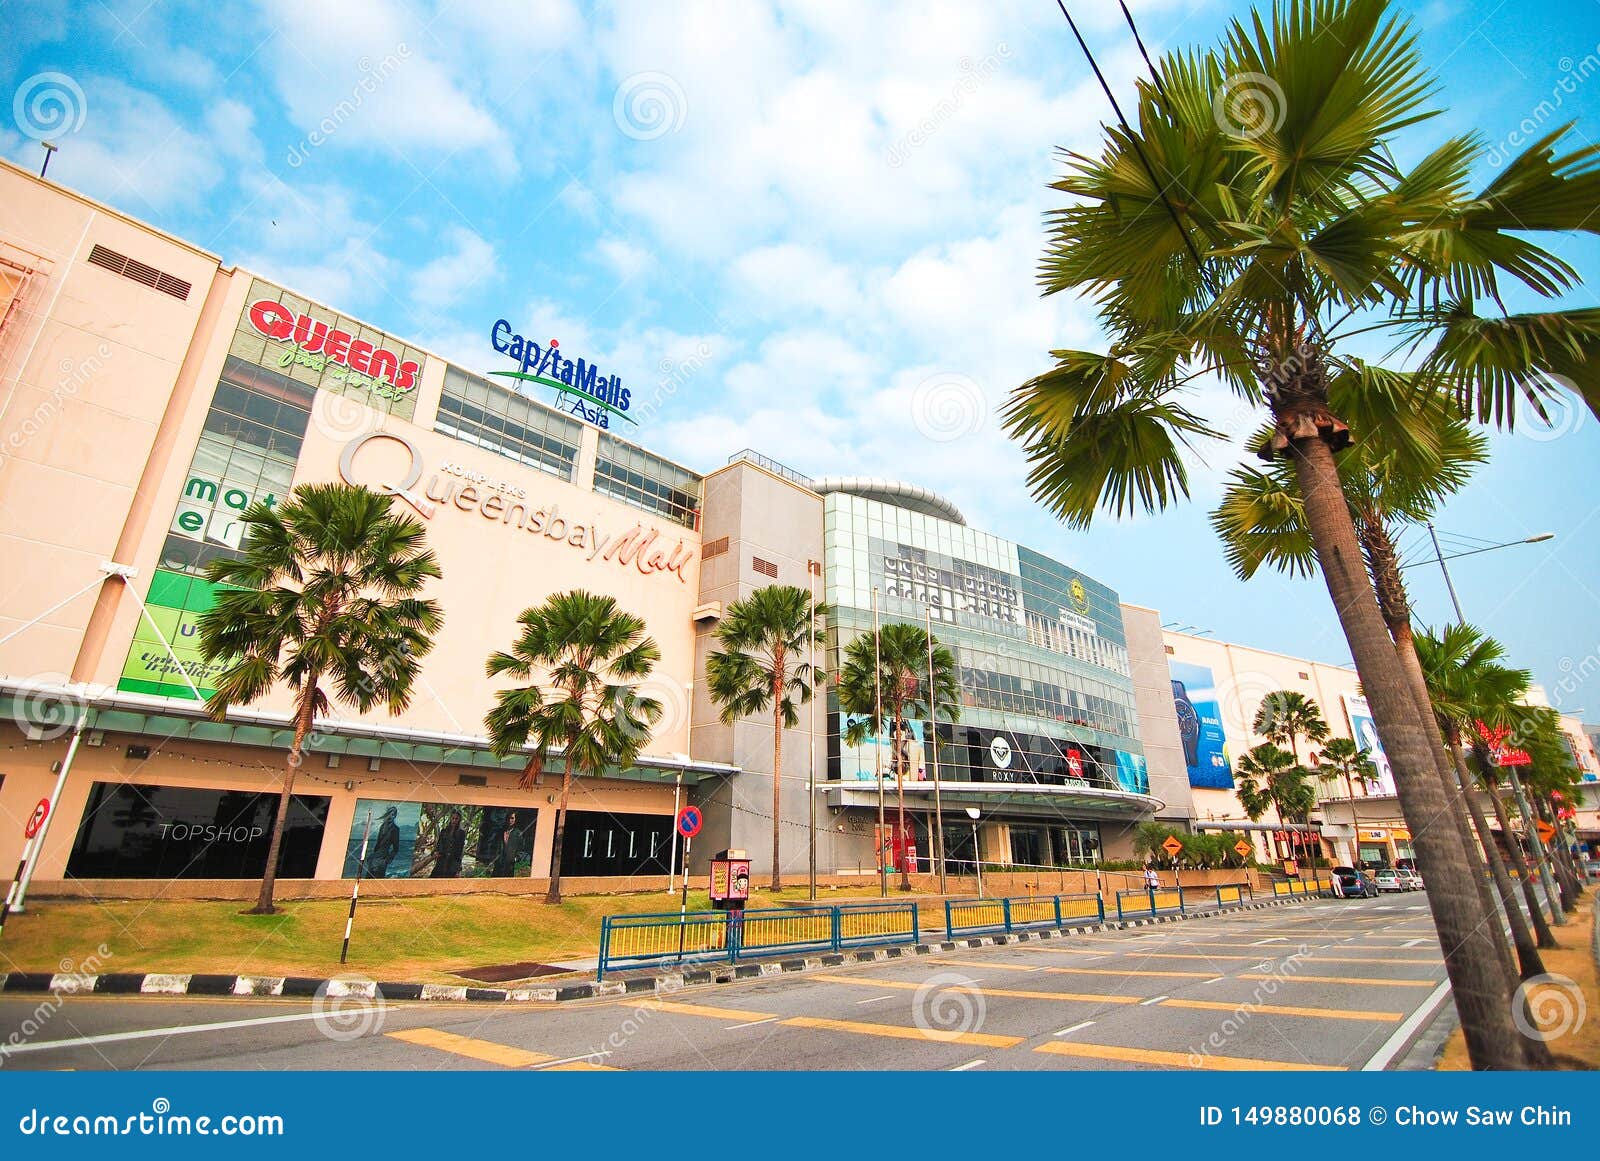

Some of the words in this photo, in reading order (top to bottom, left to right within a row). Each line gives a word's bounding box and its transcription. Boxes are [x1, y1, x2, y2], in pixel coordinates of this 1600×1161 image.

[247, 300, 421, 393] QUEENS
[491, 318, 631, 411] CapitaMalls
[277, 341, 337, 372] food
[331, 367, 407, 402] market
[571, 399, 610, 429] Asia
[440, 460, 528, 500] KOMPLEKS
[339, 430, 610, 562] Queensbay
[603, 525, 693, 584] Mall
[992, 771, 1014, 782] ROXY
[159, 823, 263, 842] TOPSHOP
[583, 829, 660, 858] ELLE
